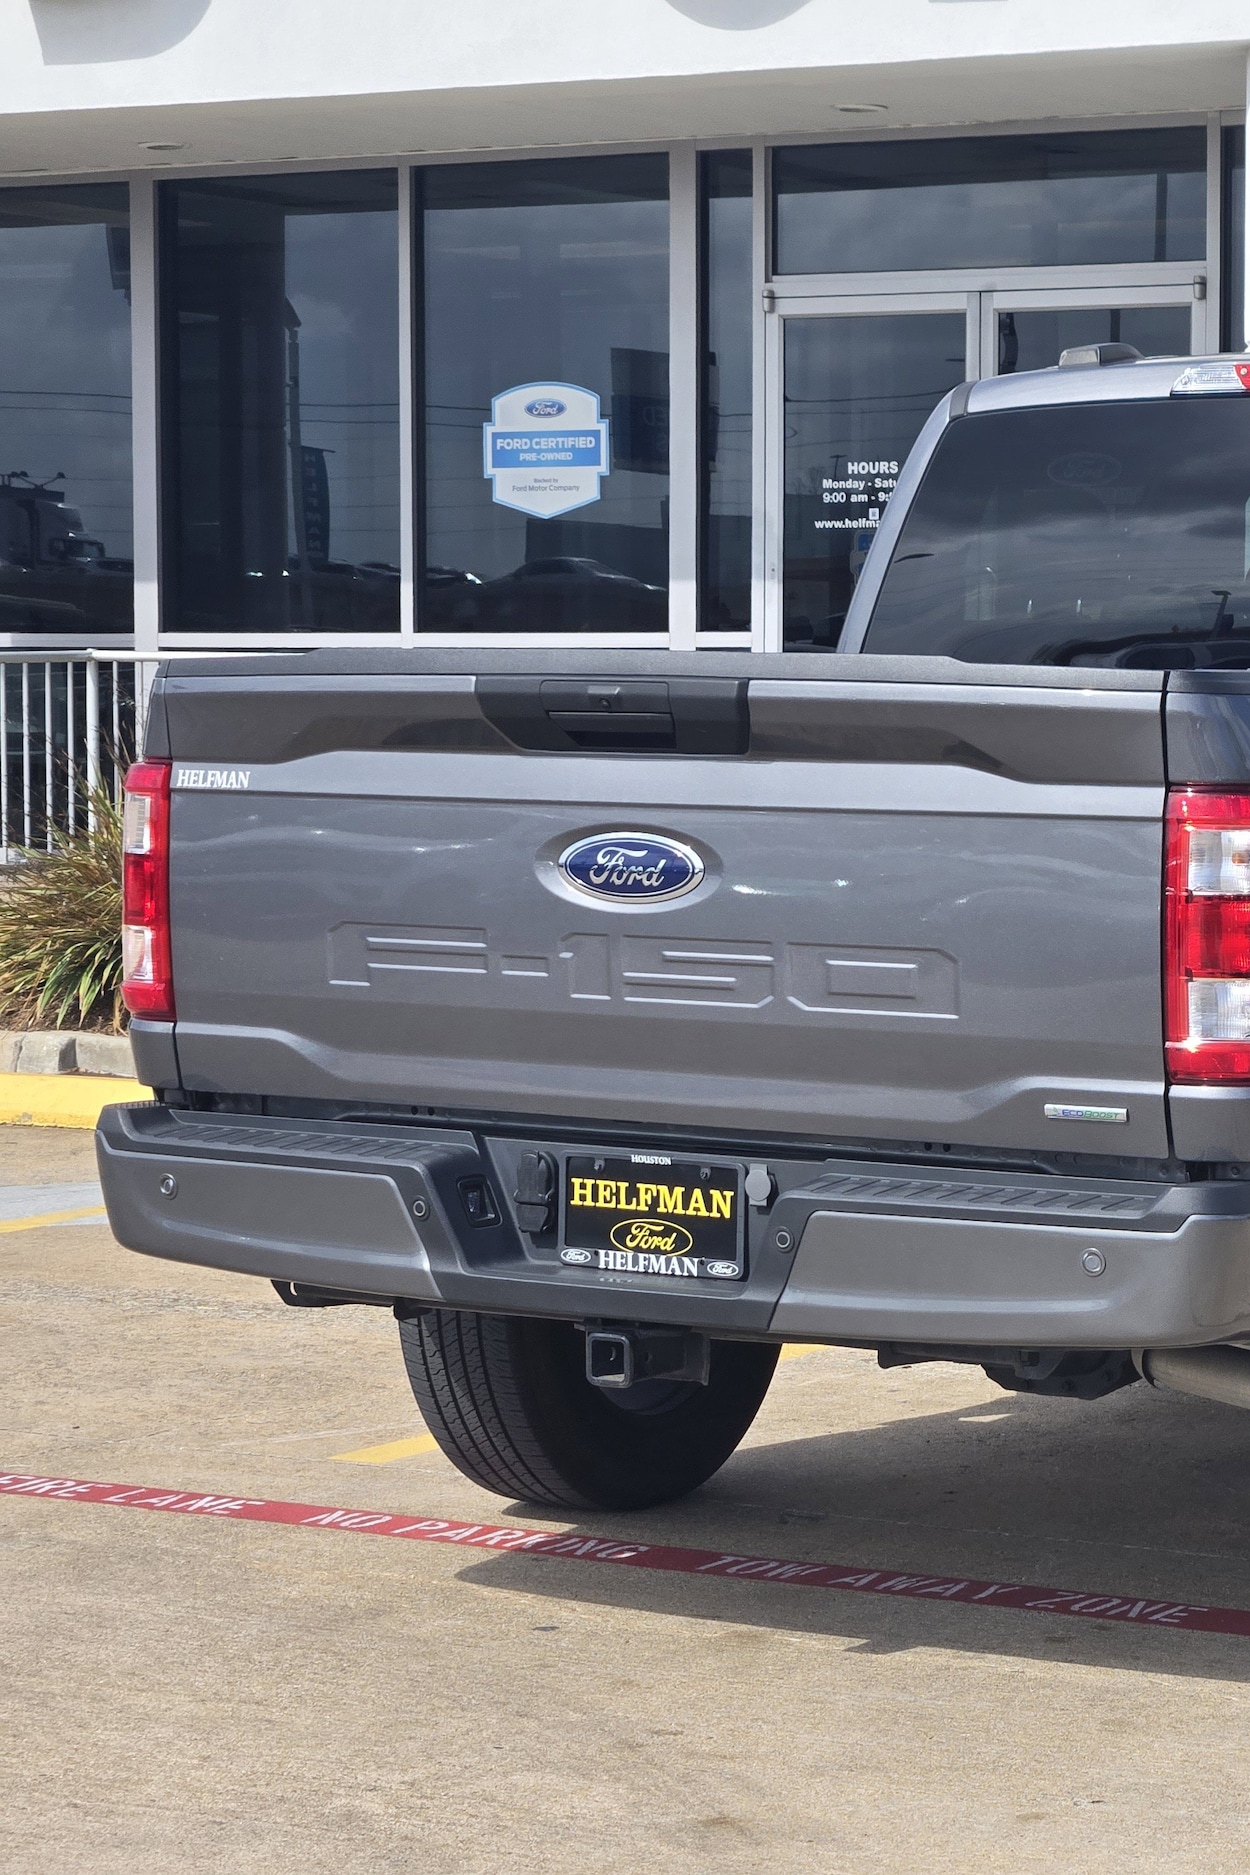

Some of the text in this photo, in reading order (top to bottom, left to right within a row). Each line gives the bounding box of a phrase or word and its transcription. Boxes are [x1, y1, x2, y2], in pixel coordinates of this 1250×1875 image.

[532, 401, 559, 415] Ford
[496, 436, 596, 450] FORD CERTIFIED
[519, 452, 573, 461] PRE-OWNED
[847, 461, 899, 474] HOURS
[549, 484, 580, 493] Company
[822, 479, 865, 490] Monday
[823, 492, 847, 503] 9:00
[850, 494, 868, 503] am
[176, 769, 251, 788] HELFMAN
[589, 846, 667, 887] Ford
[328, 921, 958, 1019] F-150
[630, 1154, 672, 1166] HOUSTON
[570, 1177, 734, 1219] HELFMAN
[625, 1222, 678, 1252] Ford
[566, 1251, 587, 1262] Ford
[598, 1249, 700, 1277] HELFMAN
[711, 1264, 734, 1275] Ford
[102, 1488, 266, 1515] LANE
[300, 1510, 393, 1529] NO
[391, 1520, 650, 1560] PARKING
[695, 1555, 828, 1580] TOW
[826, 1572, 1023, 1600] AWAY
[1024, 1591, 1210, 1624] ZONE
